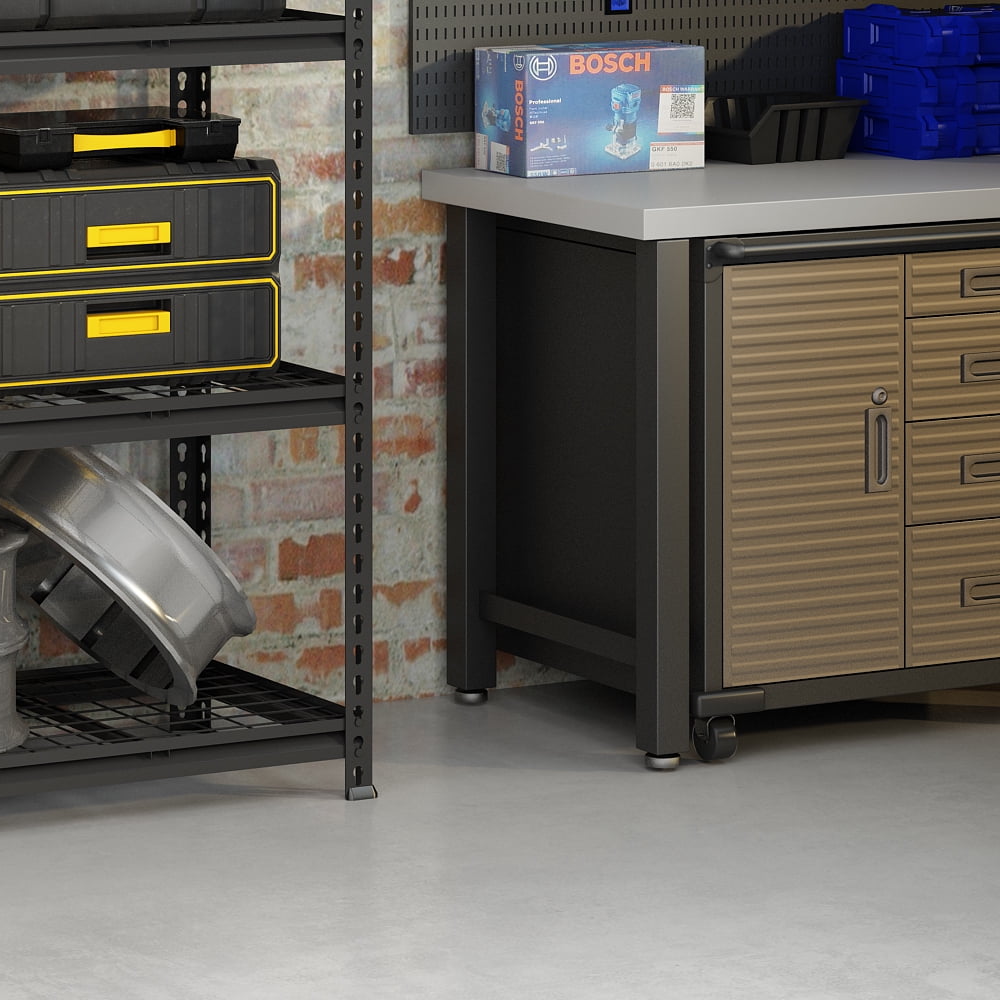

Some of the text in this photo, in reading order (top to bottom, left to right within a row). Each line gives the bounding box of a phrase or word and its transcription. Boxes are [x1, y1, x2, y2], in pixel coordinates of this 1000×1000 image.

[569, 52, 651, 75] BOSCH
[514, 80, 524, 142] BOSCH
[529, 97, 562, 105] Professional
